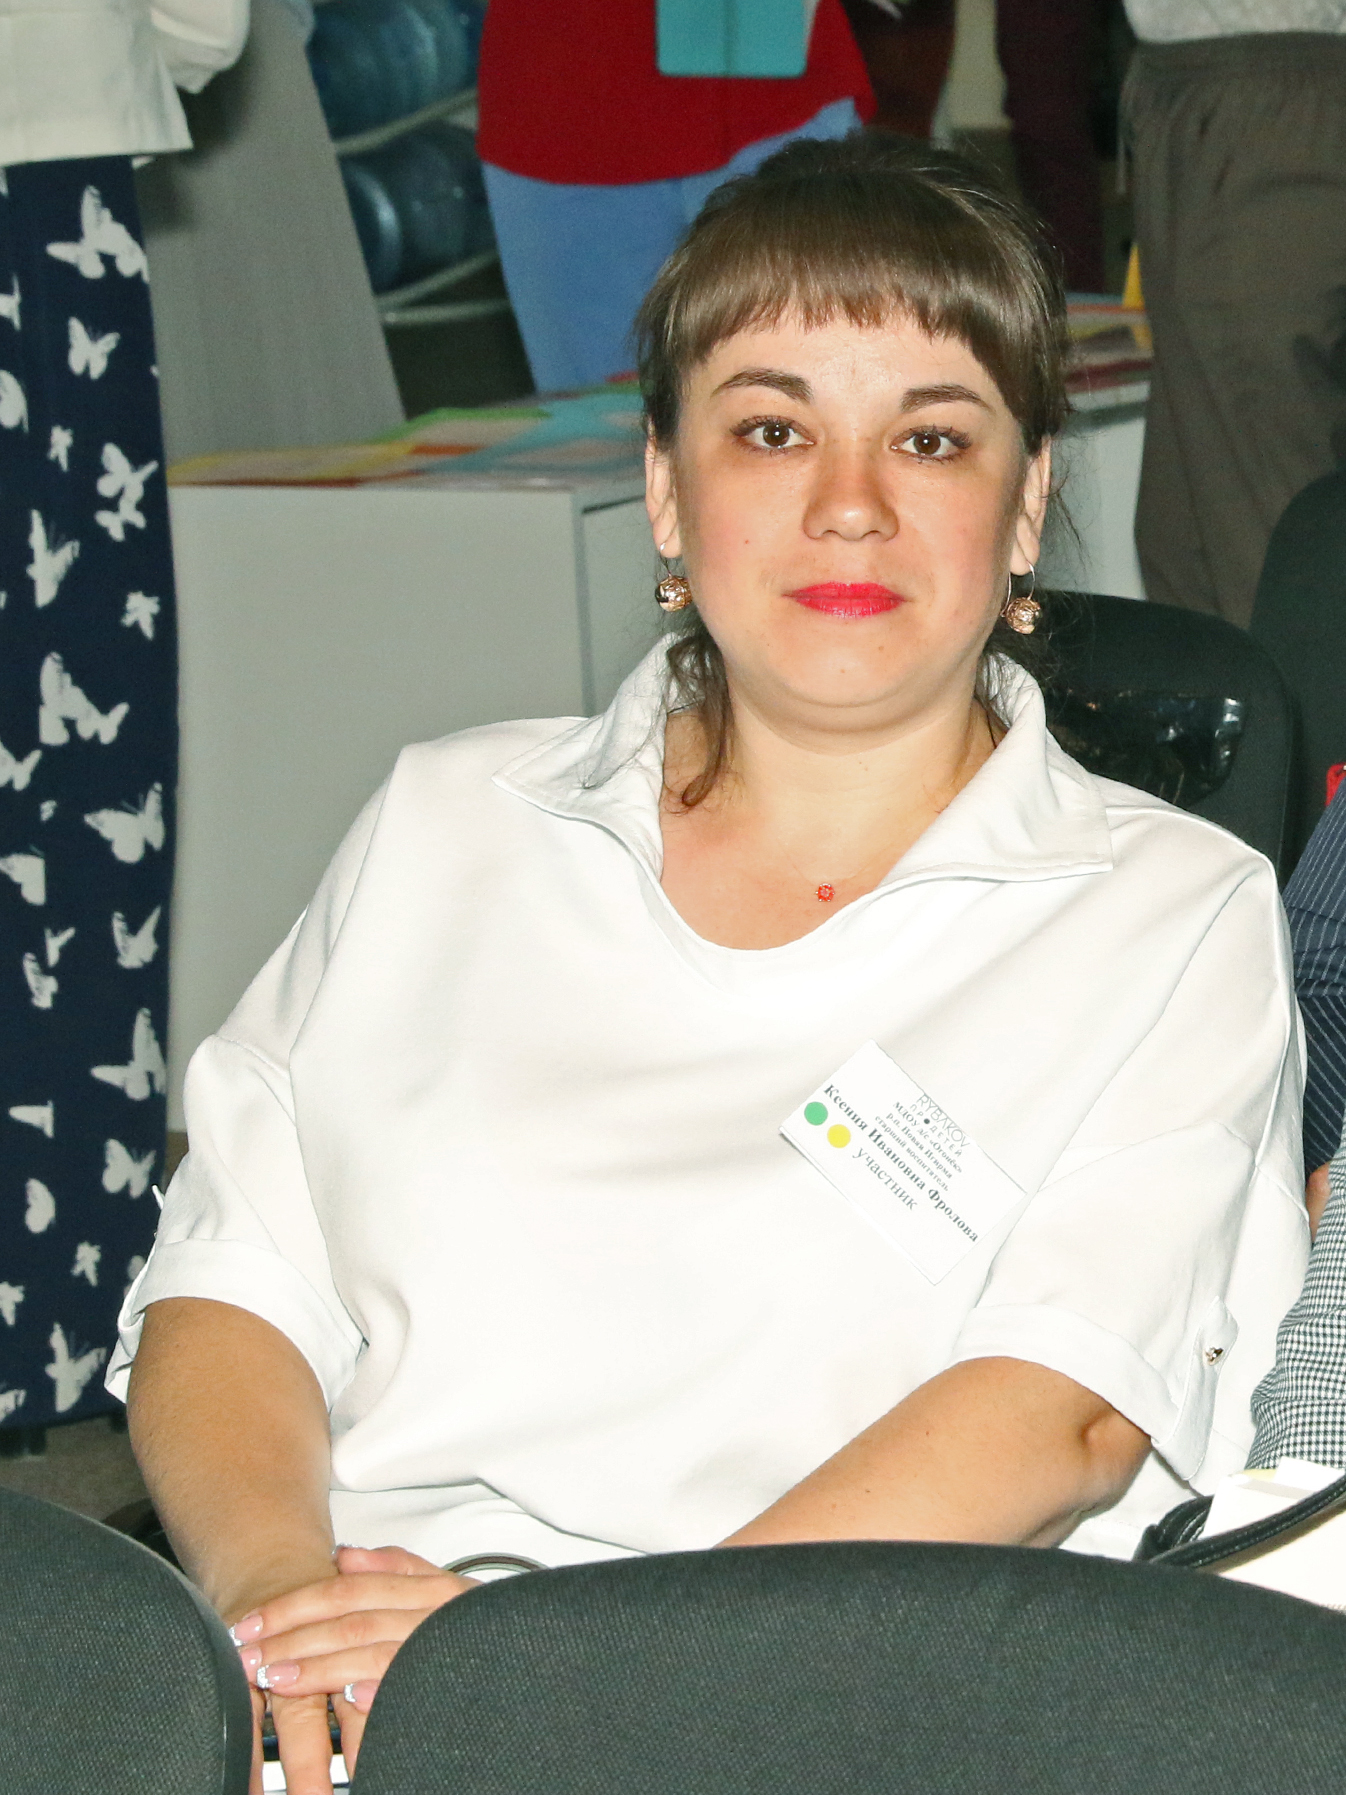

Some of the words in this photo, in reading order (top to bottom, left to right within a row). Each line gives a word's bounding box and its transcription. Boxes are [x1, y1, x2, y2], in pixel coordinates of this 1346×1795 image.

[892, 1101, 921, 1127] МДОУ
[900, 1125, 925, 1151] Новая
[823, 1083, 869, 1132] Ксения
[867, 1127, 926, 1191] Ивановна
[927, 1188, 979, 1243] Фролова
[851, 1147, 918, 1211] участник
[874, 1115, 908, 1149] старший
[905, 1147, 949, 1192] воспитатель
